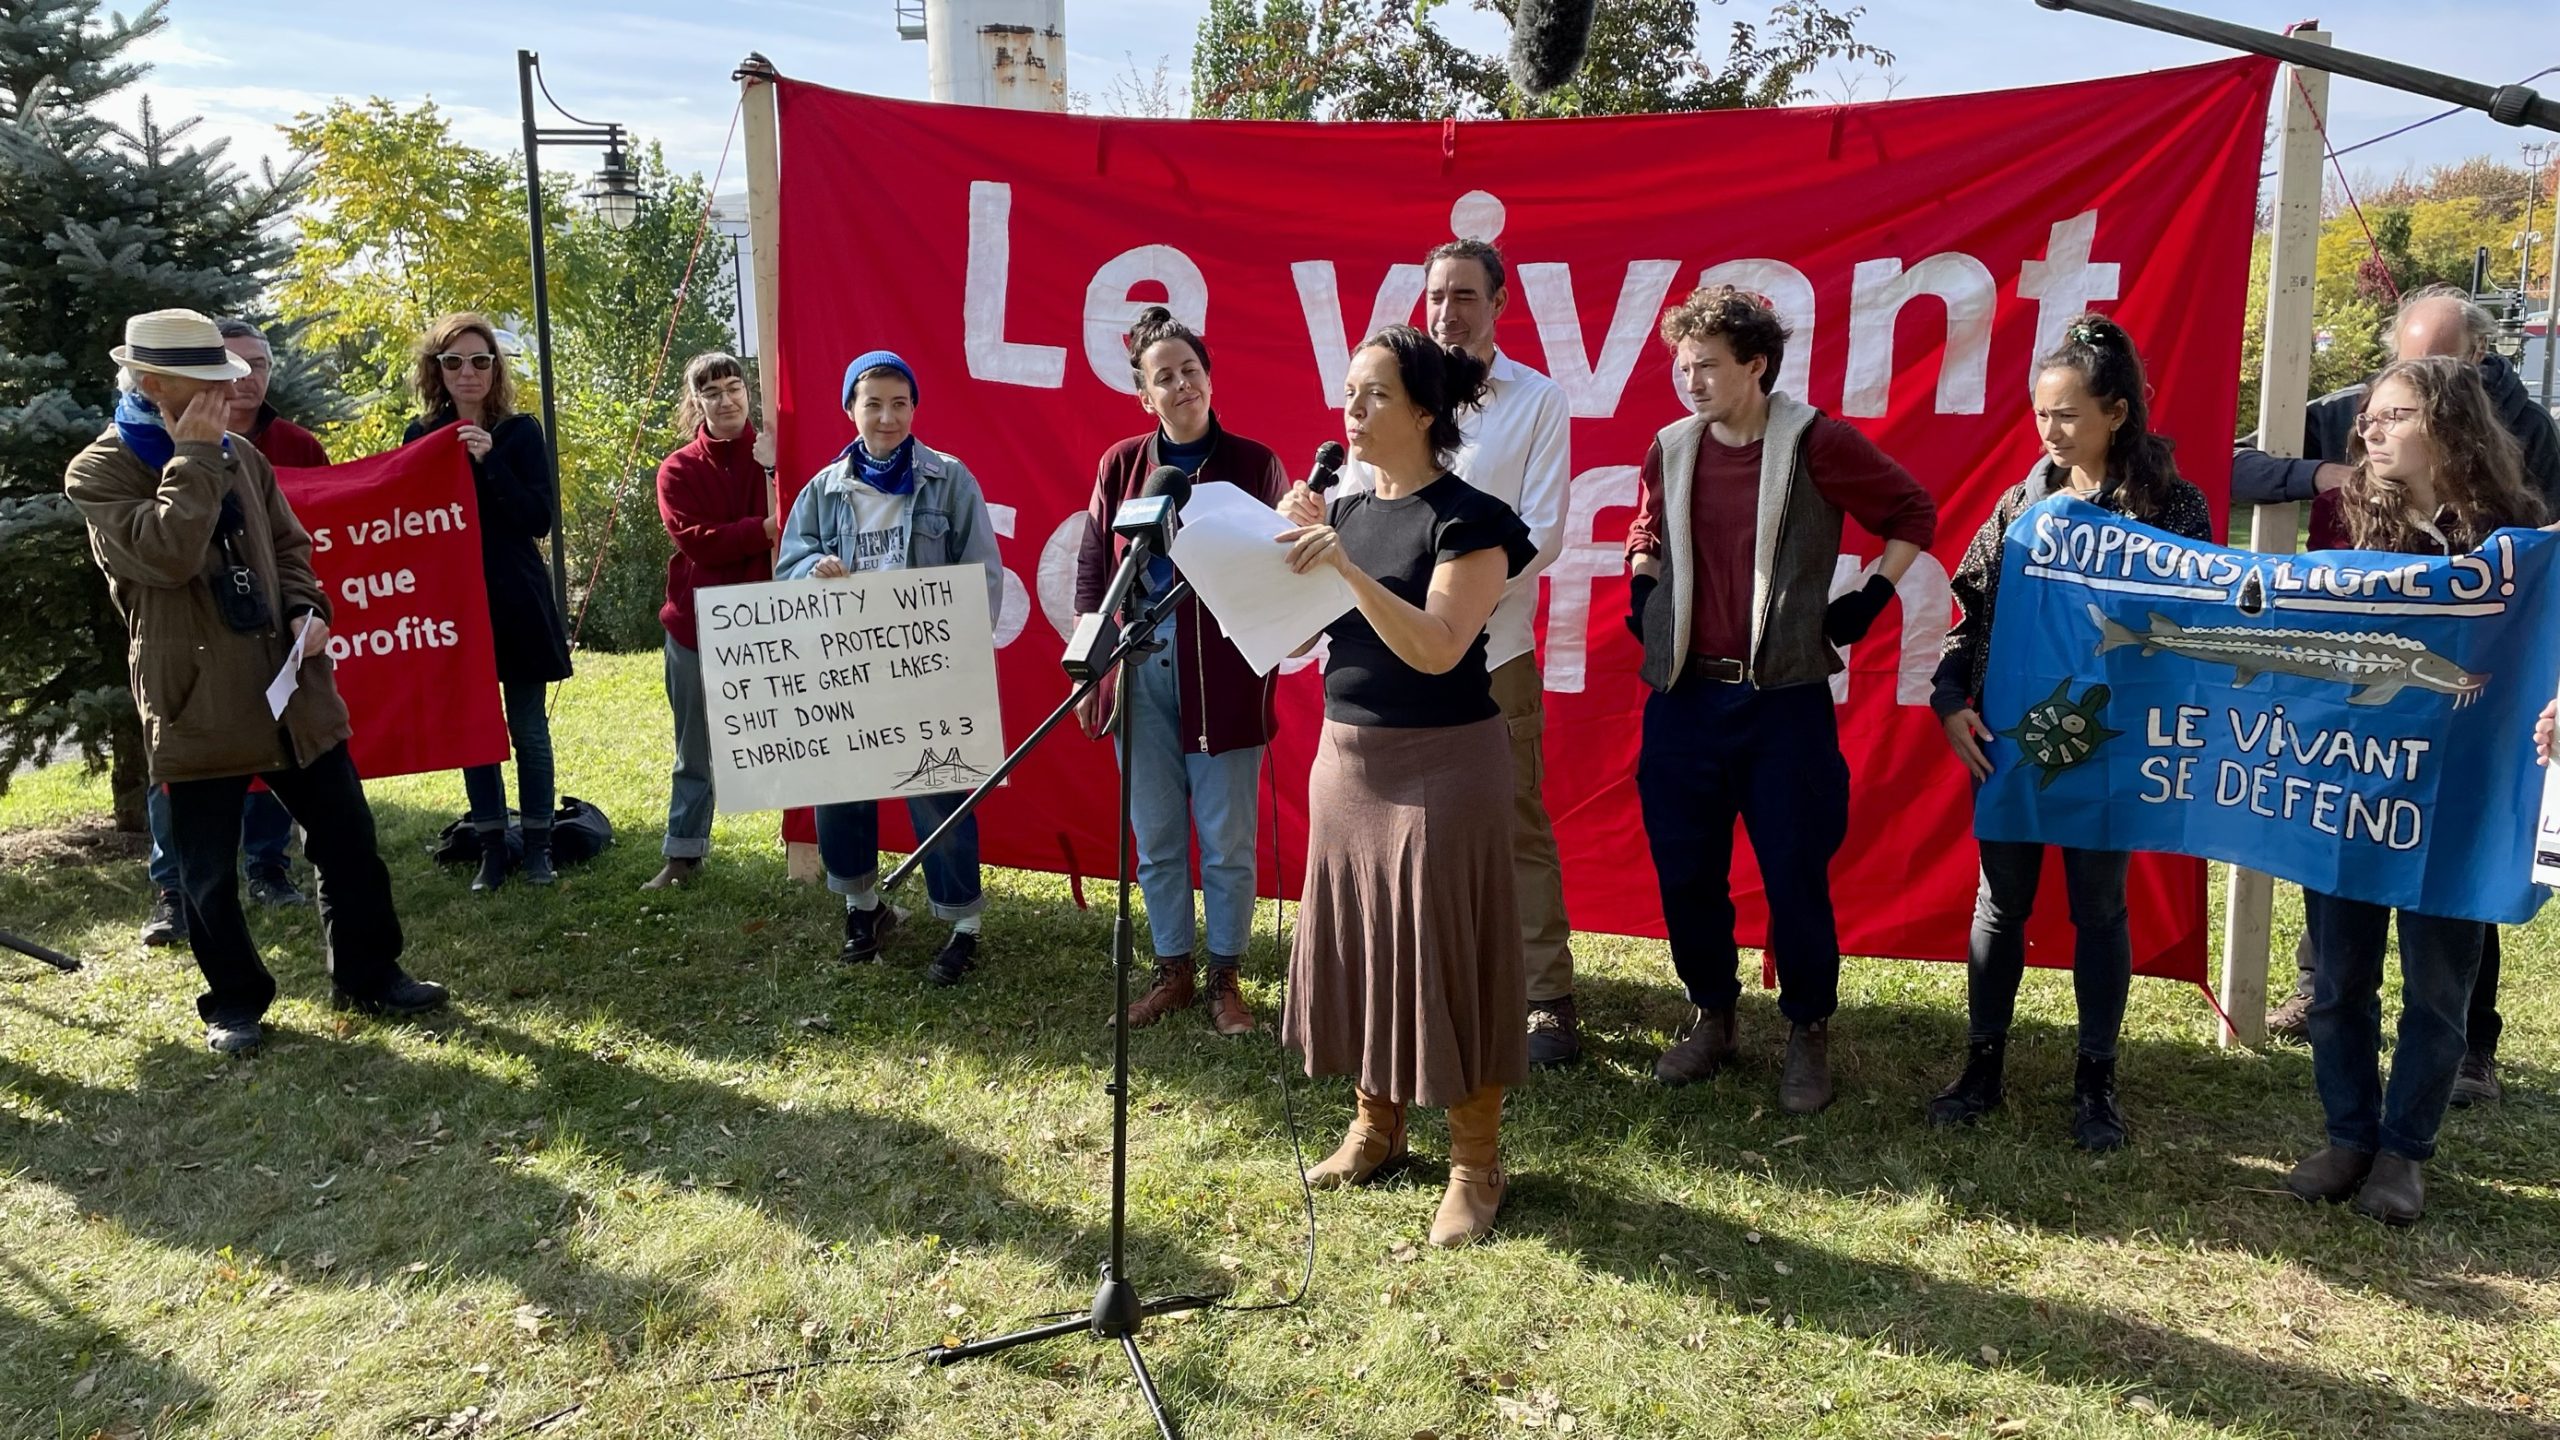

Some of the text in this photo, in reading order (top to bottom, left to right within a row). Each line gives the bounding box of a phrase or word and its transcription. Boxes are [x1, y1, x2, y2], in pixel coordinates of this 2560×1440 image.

[964, 180, 1208, 396] Le
[347, 502, 467, 545] valent
[2030, 511, 2243, 586] STOPPONS
[341, 568, 416, 609] que
[325, 615, 459, 671] profits
[716, 619, 951, 666] WATER PROTECTORS
[722, 653, 951, 700] OF THE GREAT LAKES:
[724, 701, 855, 735] SHUT DOWN
[919, 721, 933, 740] 5
[939, 719, 952, 735] &
[959, 716, 973, 735] 3
[2146, 703, 2209, 749] LE
[2140, 755, 2423, 852] SE DÉFEND
